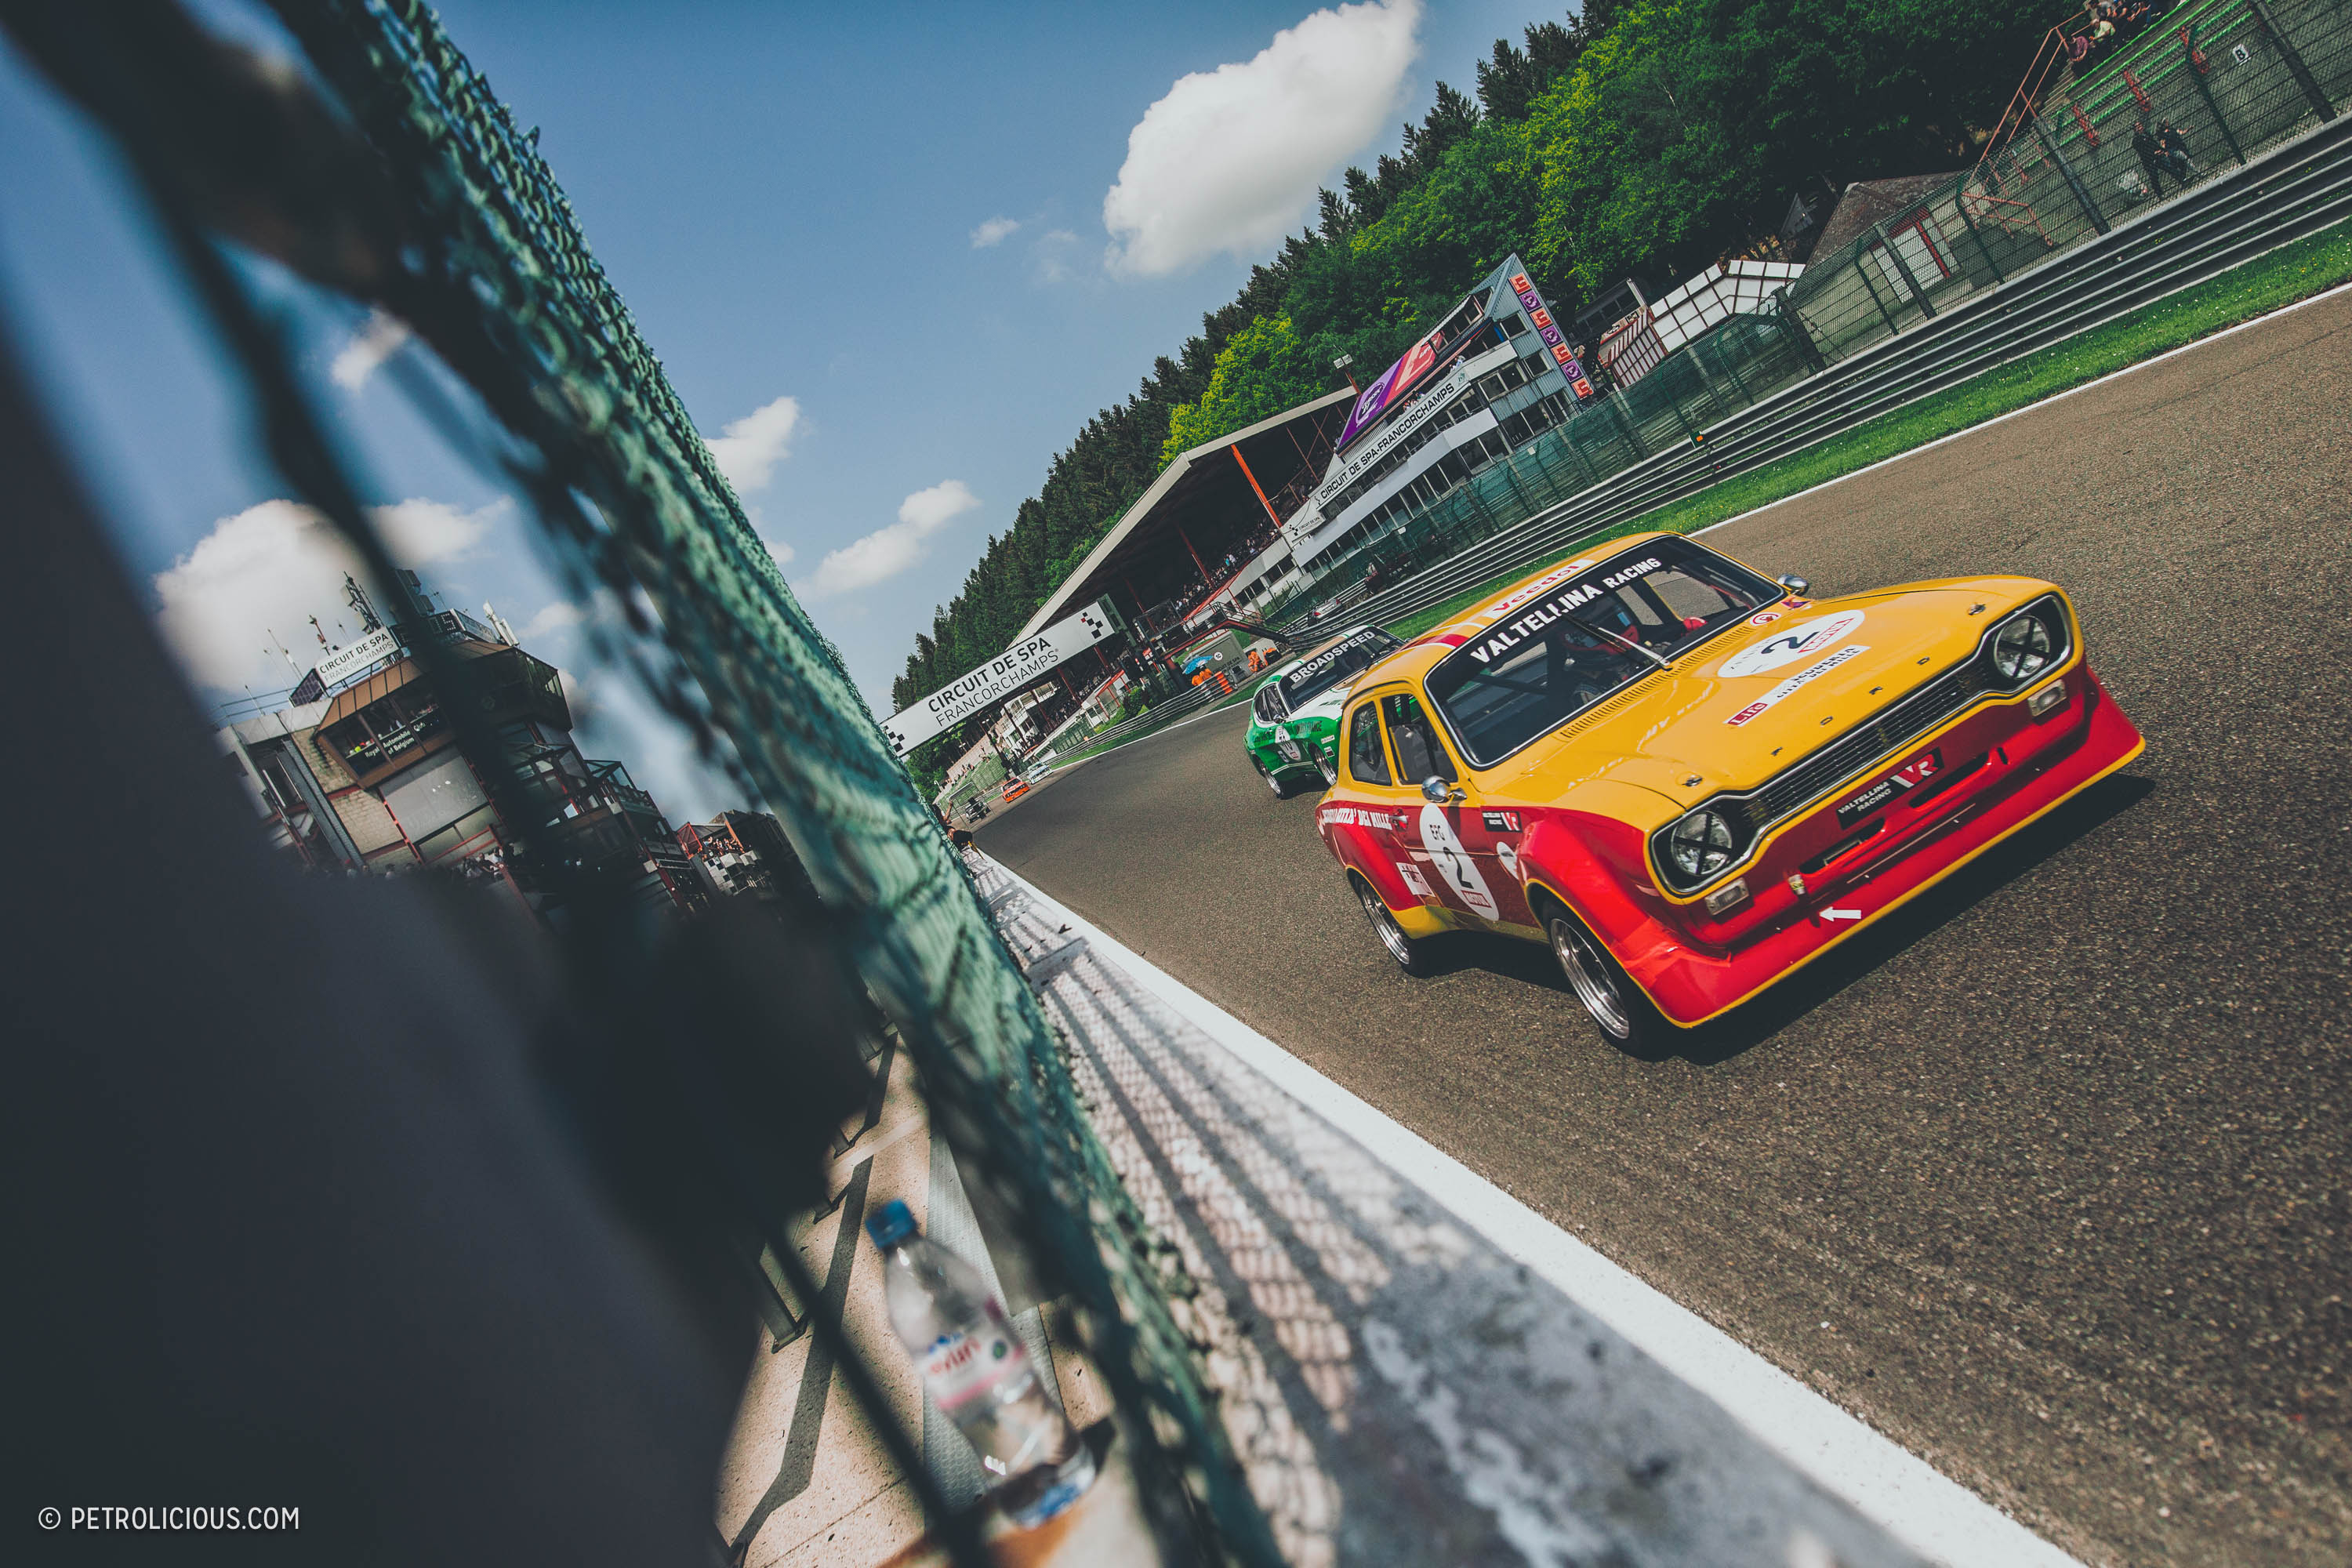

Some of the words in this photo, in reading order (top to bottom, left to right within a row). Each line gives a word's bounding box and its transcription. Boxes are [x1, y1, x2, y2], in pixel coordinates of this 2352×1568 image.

[1320, 472, 1348, 499] CIRCUIT
[1348, 462, 1361, 476] DE
[1470, 583, 1604, 663] VALTELLINA
[1602, 557, 1662, 589] RACING
[320, 650, 355, 674] CIRCUIT
[356, 643, 369, 655] DE
[369, 633, 389, 647] SPA
[325, 641, 394, 681] FRANCORCHAMPS
[1289, 631, 1375, 683] BROADSPEED
[1761, 631, 1820, 654] 2
[928, 669, 990, 713] CIRCUIT
[992, 655, 1017, 677] DE
[1017, 637, 1051, 662] SPA
[1791, 648, 1856, 681] SCUDERIA
[936, 650, 1058, 727] FRANCORCHAMPS
[365, 746, 380, 758] Royal
[383, 730, 411, 748] Automobile
[393, 737, 415, 751] Belgium
[1838, 781, 1889, 814] VALTELLINA
[1857, 788, 1892, 811] RACING
[1443, 847, 1475, 890] 2
